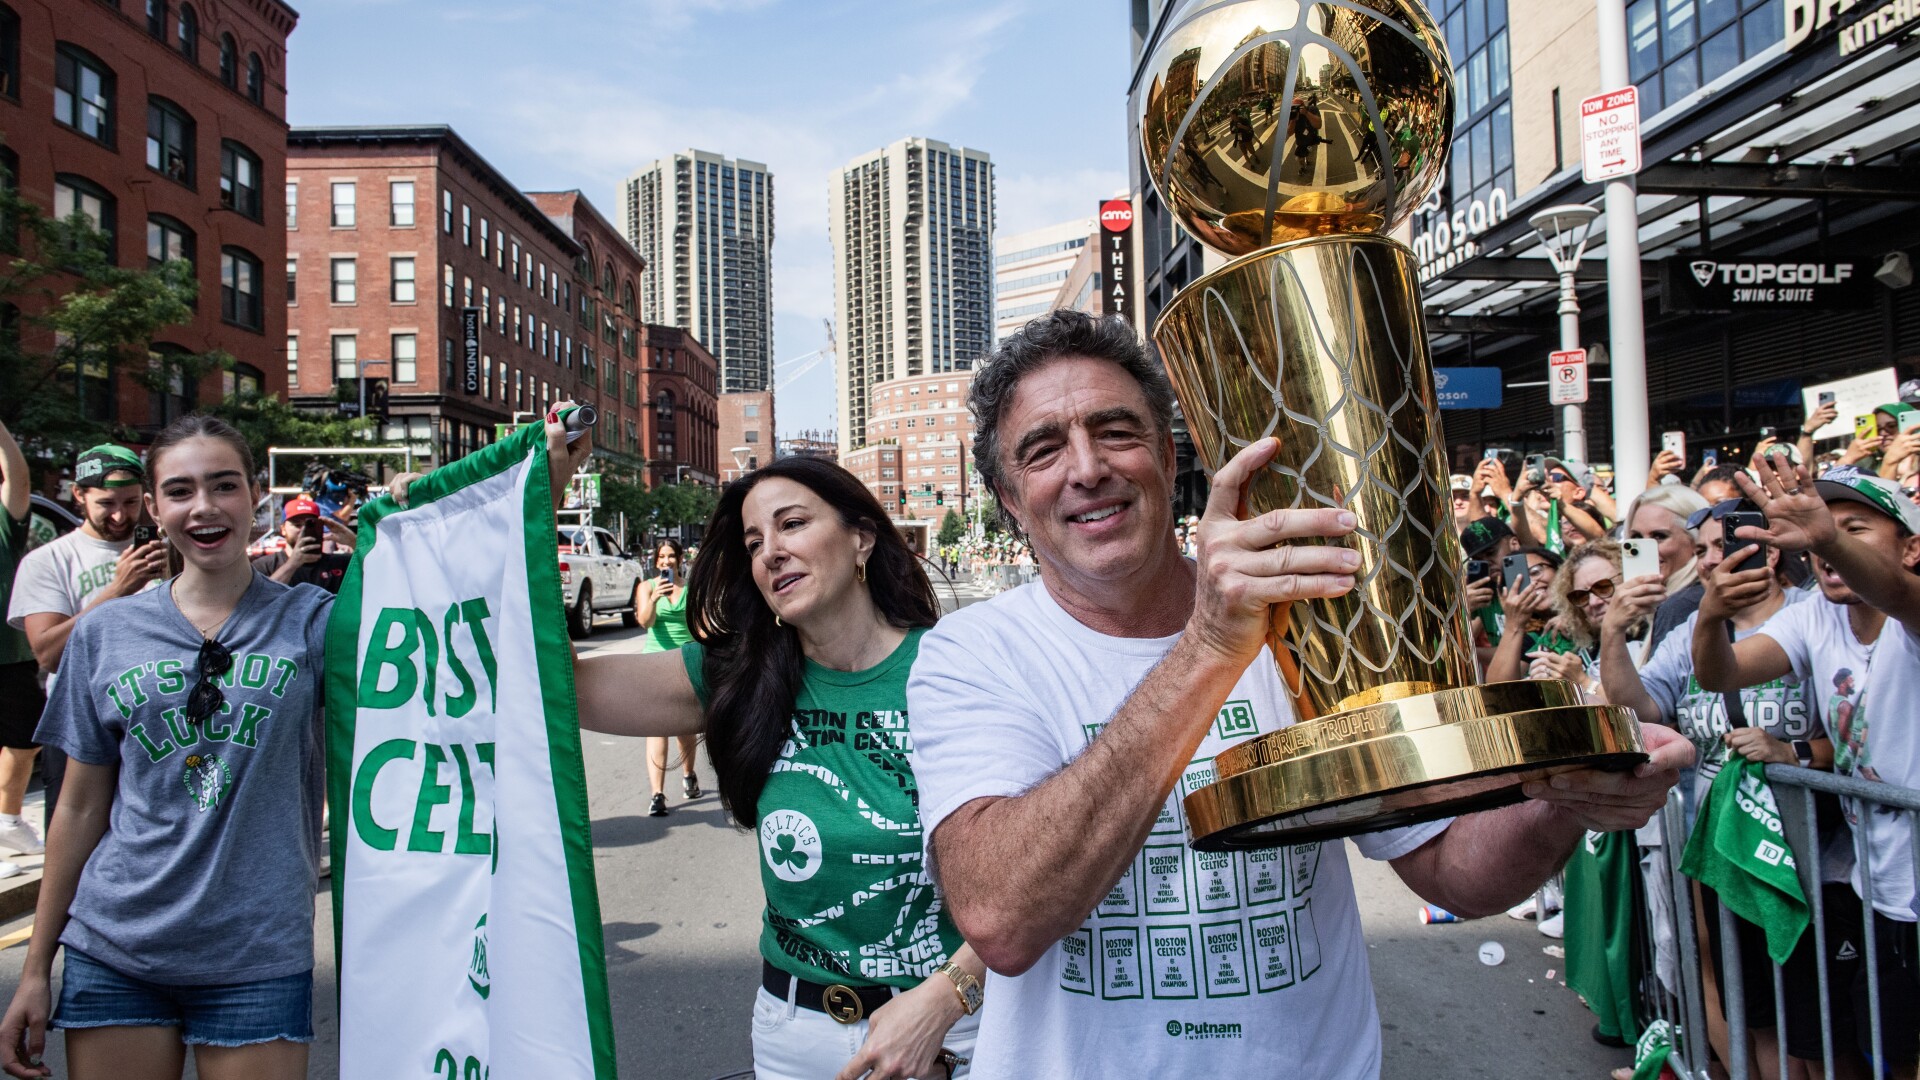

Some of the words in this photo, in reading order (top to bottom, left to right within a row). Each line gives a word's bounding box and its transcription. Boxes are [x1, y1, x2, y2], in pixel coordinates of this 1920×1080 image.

[1583, 99, 1604, 113] TOW
[1606, 91, 1634, 108] ZONE
[1599, 113, 1619, 127] NO
[1586, 122, 1634, 141] STOPPING
[1600, 137, 1620, 148] ANY
[1599, 147, 1622, 159] TIME
[1101, 210, 1132, 220] amc
[1717, 264, 1853, 284] TOPGOLF
[1733, 288, 1775, 302] SWING
[1778, 288, 1814, 301] SUITE
[466, 314, 476, 341] hotel
[466, 346, 477, 391] INDIGO
[107, 659, 186, 720] IT'S
[1221, 706, 1249, 731] 18
[129, 700, 272, 763] LUCK
[1314, 708, 1387, 750] TROPHY
[763, 815, 816, 846] CELTICS
[1294, 843, 1316, 855] CELTICS
[1149, 856, 1179, 865] BOSTON
[1198, 851, 1229, 861] BOSTON
[1250, 852, 1278, 863] CELTICS
[1151, 865, 1178, 874] CELTICS
[1200, 860, 1228, 870] CELTICS
[1254, 884, 1277, 893] CHAMPIONS
[1206, 892, 1230, 901] CHAMPIONS
[1257, 924, 1285, 938] BOSTON
[1106, 939, 1133, 948] BOSTON
[1154, 937, 1186, 947] BOSTON
[1207, 932, 1237, 944] BOSTON
[1259, 935, 1285, 947] CELTICS
[1062, 942, 1085, 956] CELTICS
[1107, 948, 1132, 958] CELTICS
[1157, 947, 1186, 956] CELTICS
[1210, 943, 1237, 953] CELTICS
[1065, 968, 1080, 976] WORLD
[1268, 963, 1282, 971] WORLD
[1062, 973, 1086, 983] CHAMPIONS
[1265, 969, 1287, 979] CHAMPIONS
[1111, 981, 1133, 989] CHAMPIONS
[1214, 977, 1240, 985] CHAMPIONS
[1185, 1022, 1242, 1034] Putnam
